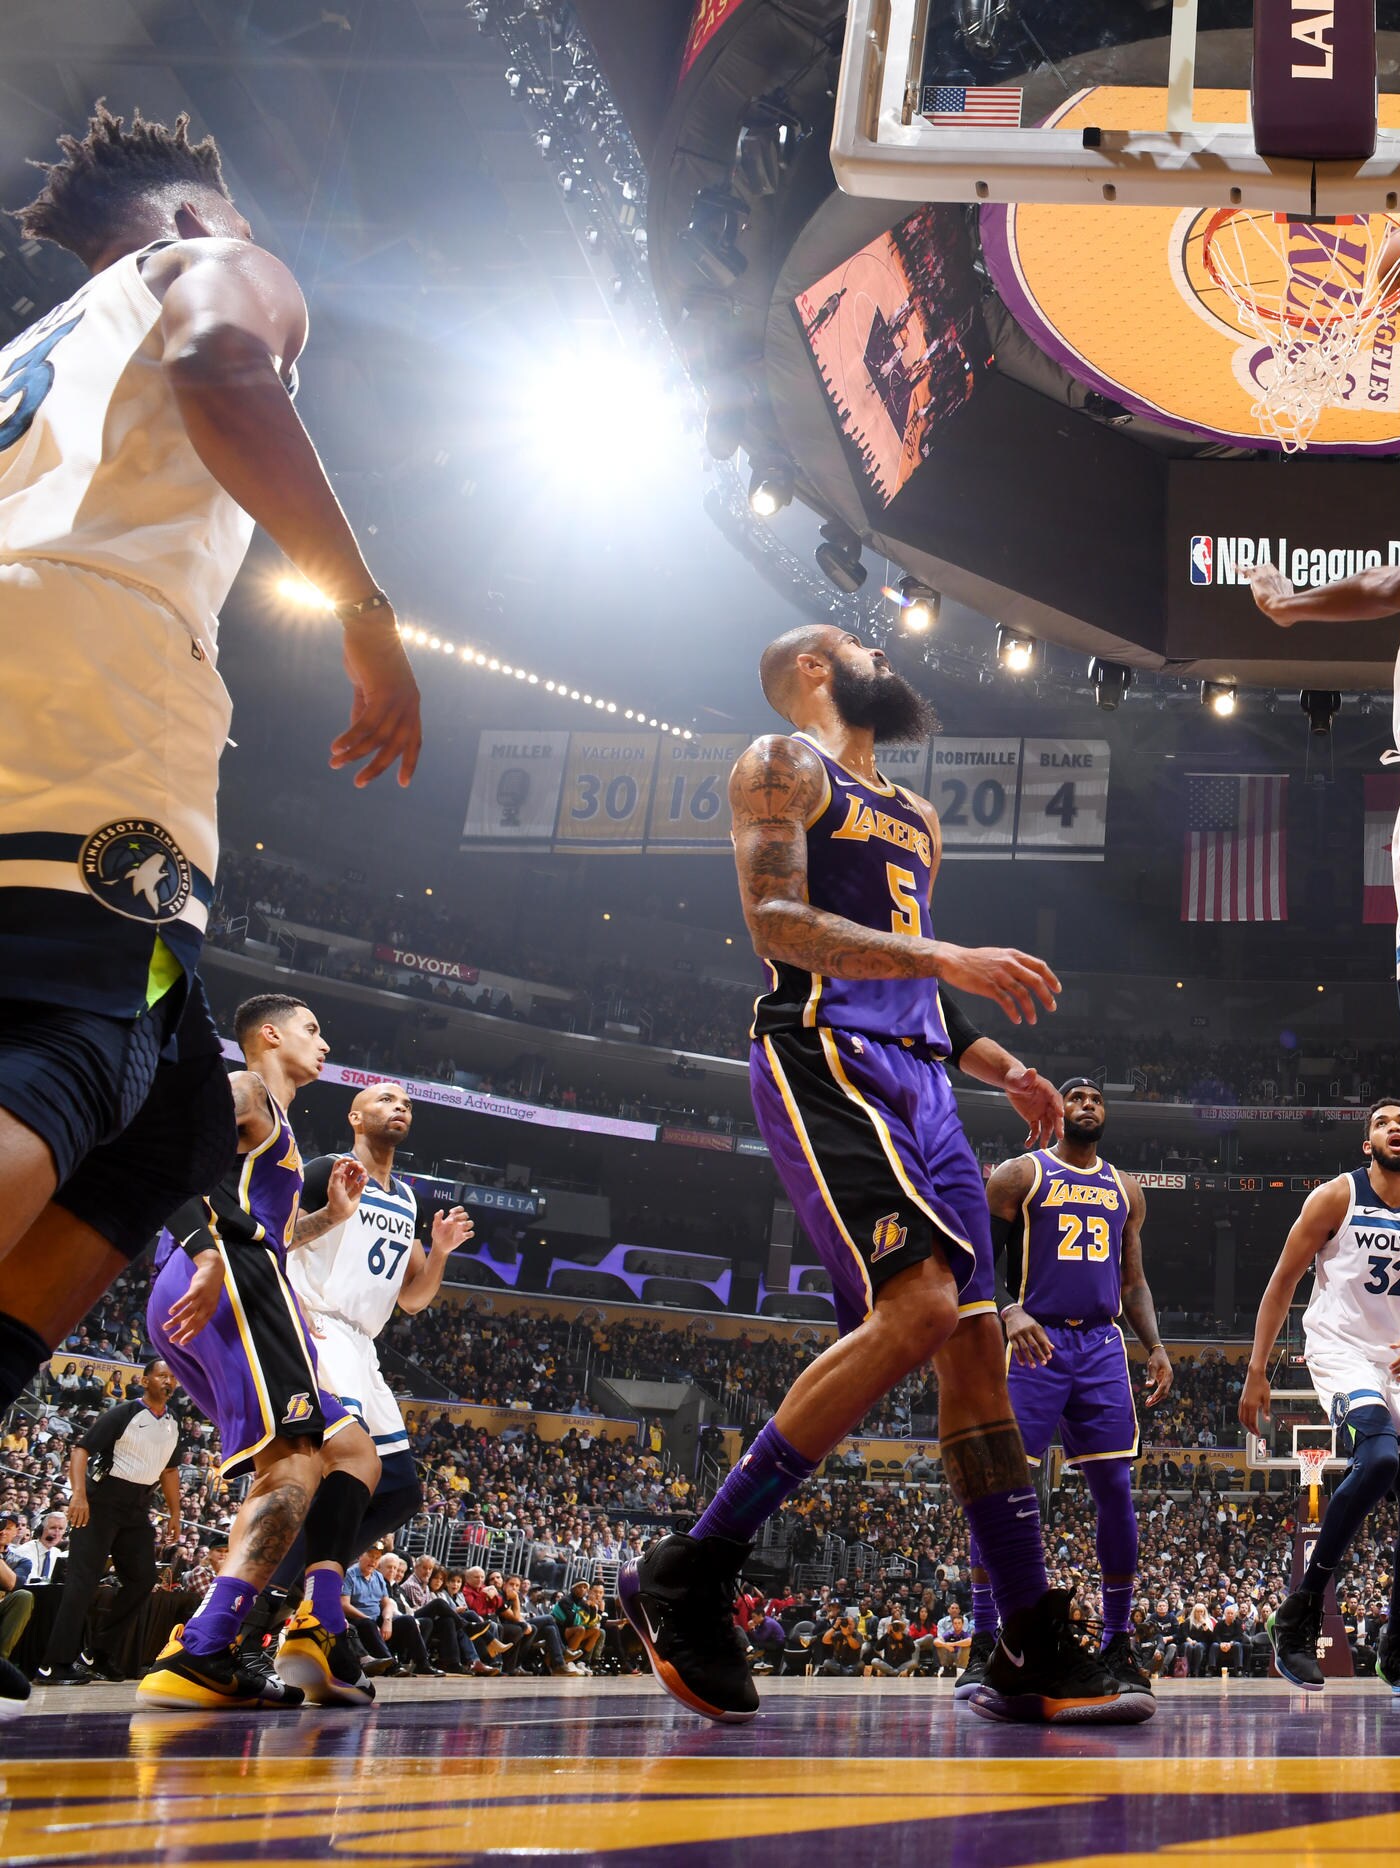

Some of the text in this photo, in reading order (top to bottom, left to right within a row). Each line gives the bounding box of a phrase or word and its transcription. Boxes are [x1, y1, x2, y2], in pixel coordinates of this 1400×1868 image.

[491, 744, 553, 760] MILLER
[582, 746, 646, 761] VACHON
[935, 751, 1016, 767] ROBITAILLE
[1040, 753, 1094, 769] BLAKE
[571, 773, 638, 822] 30
[669, 774, 721, 822] 16
[941, 777, 1007, 827] 20
[1045, 781, 1078, 828] 4
[831, 793, 932, 868] LAKERS
[85, 822, 190, 914] MINNESOTA TIMBERWOLVES
[886, 861, 922, 938] 5
[393, 949, 461, 978] TOYOTA
[406, 1082, 462, 1107] Business
[1259, 1109, 1275, 1120] TEXT
[433, 1189, 454, 1201] NHL
[484, 1194, 536, 1213] DELTA
[1040, 1179, 1119, 1211] LAKERS
[359, 1208, 412, 1240] WOLVE
[1057, 1213, 1110, 1263] 23
[367, 1237, 408, 1280] 67
